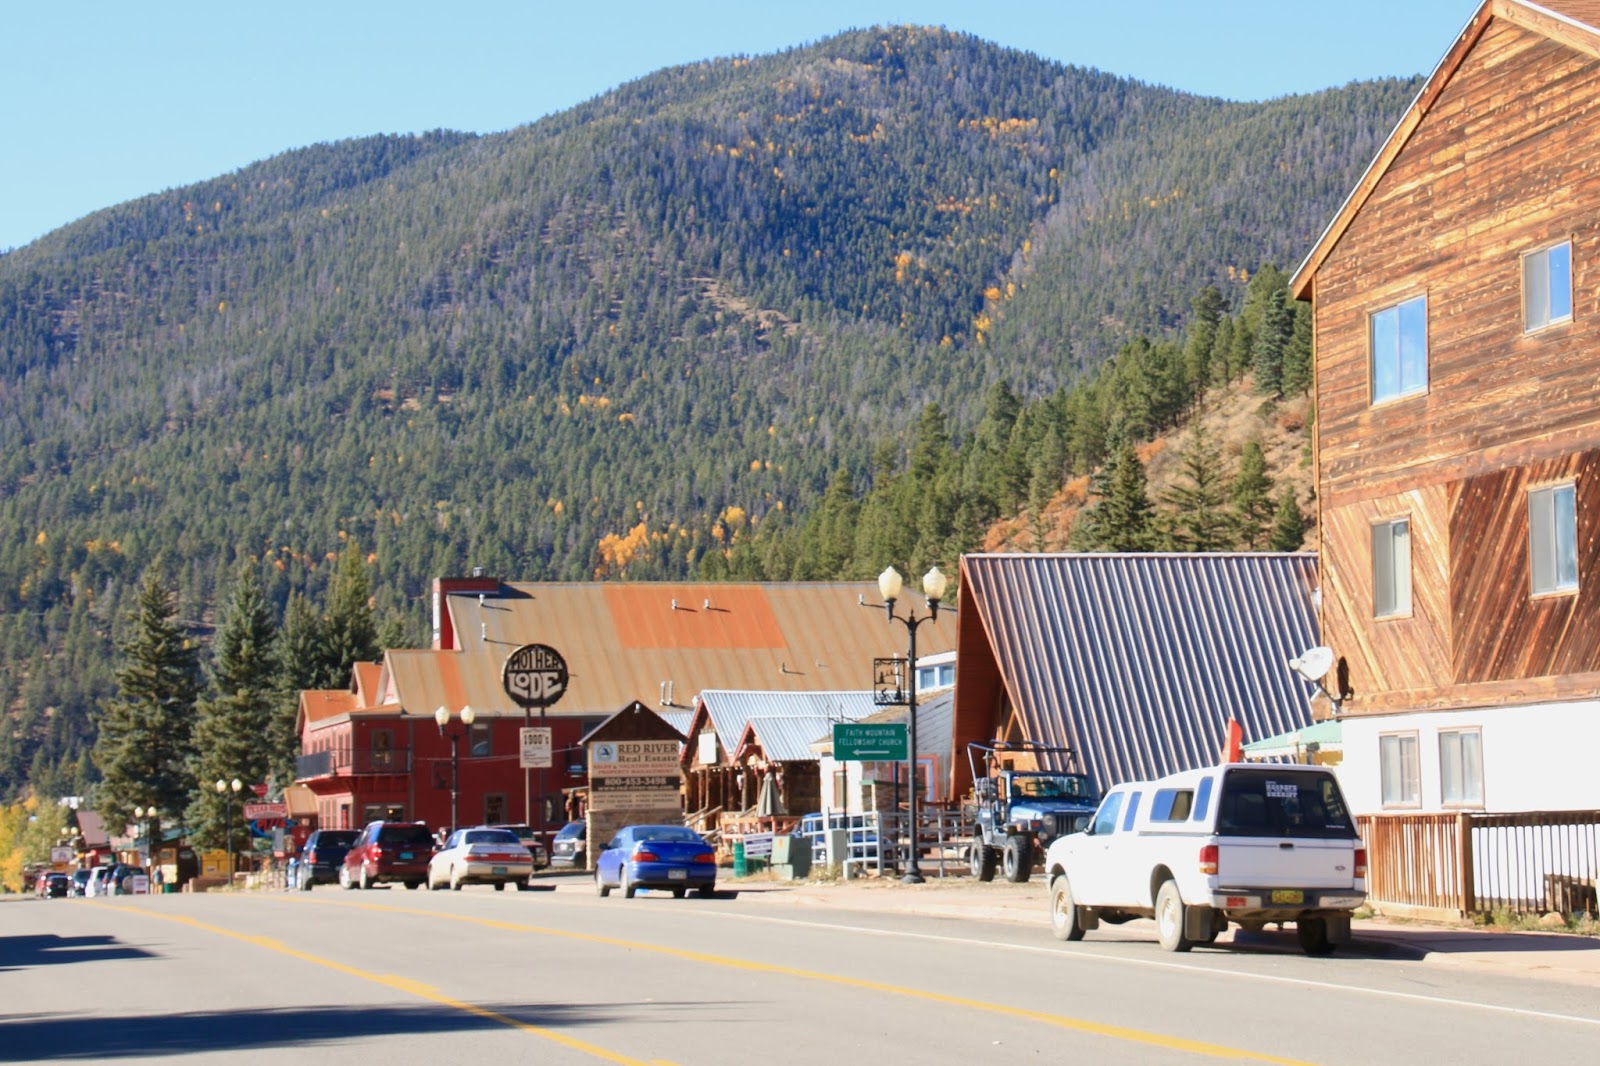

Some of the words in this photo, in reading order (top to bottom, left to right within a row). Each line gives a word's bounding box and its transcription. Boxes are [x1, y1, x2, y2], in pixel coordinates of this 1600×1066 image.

[510, 648, 559, 669] MOTHER
[508, 672, 562, 699] LODE
[524, 734, 549, 745] 1900's
[618, 744, 640, 753] RED
[644, 744, 677, 753] RIVER
